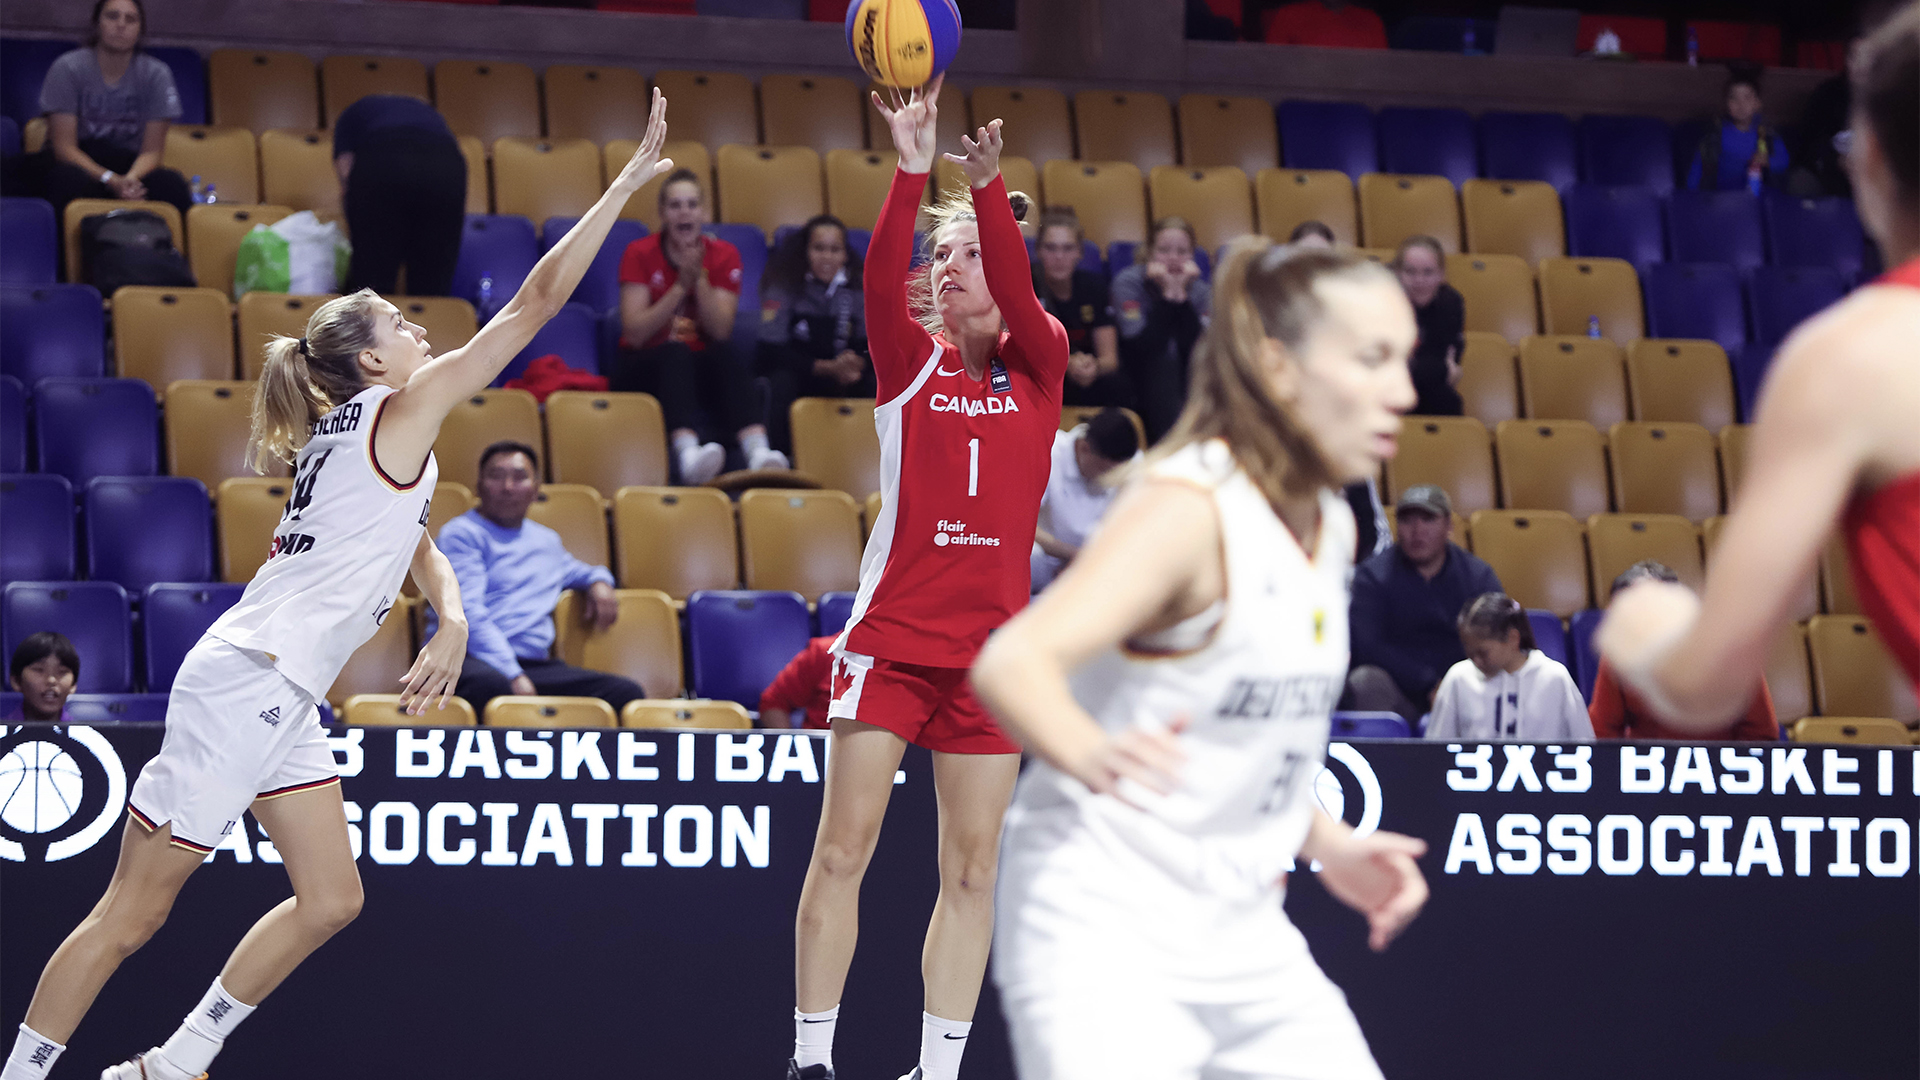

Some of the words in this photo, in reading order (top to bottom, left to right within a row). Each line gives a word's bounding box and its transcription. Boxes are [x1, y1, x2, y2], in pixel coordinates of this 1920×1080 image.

[929, 393, 1019, 417] CANADA
[968, 438, 979, 496] 1
[937, 520, 966, 531] flair
[950, 534, 1000, 546] airlines
[259, 711, 281, 728] PEAK
[396, 729, 905, 784] BASKETBA
[1447, 744, 1592, 793] 3X3
[1620, 745, 1920, 796] BASKET
[1444, 812, 1920, 877] ASSOCIATIO
[28, 1041, 57, 1069] PEAK
